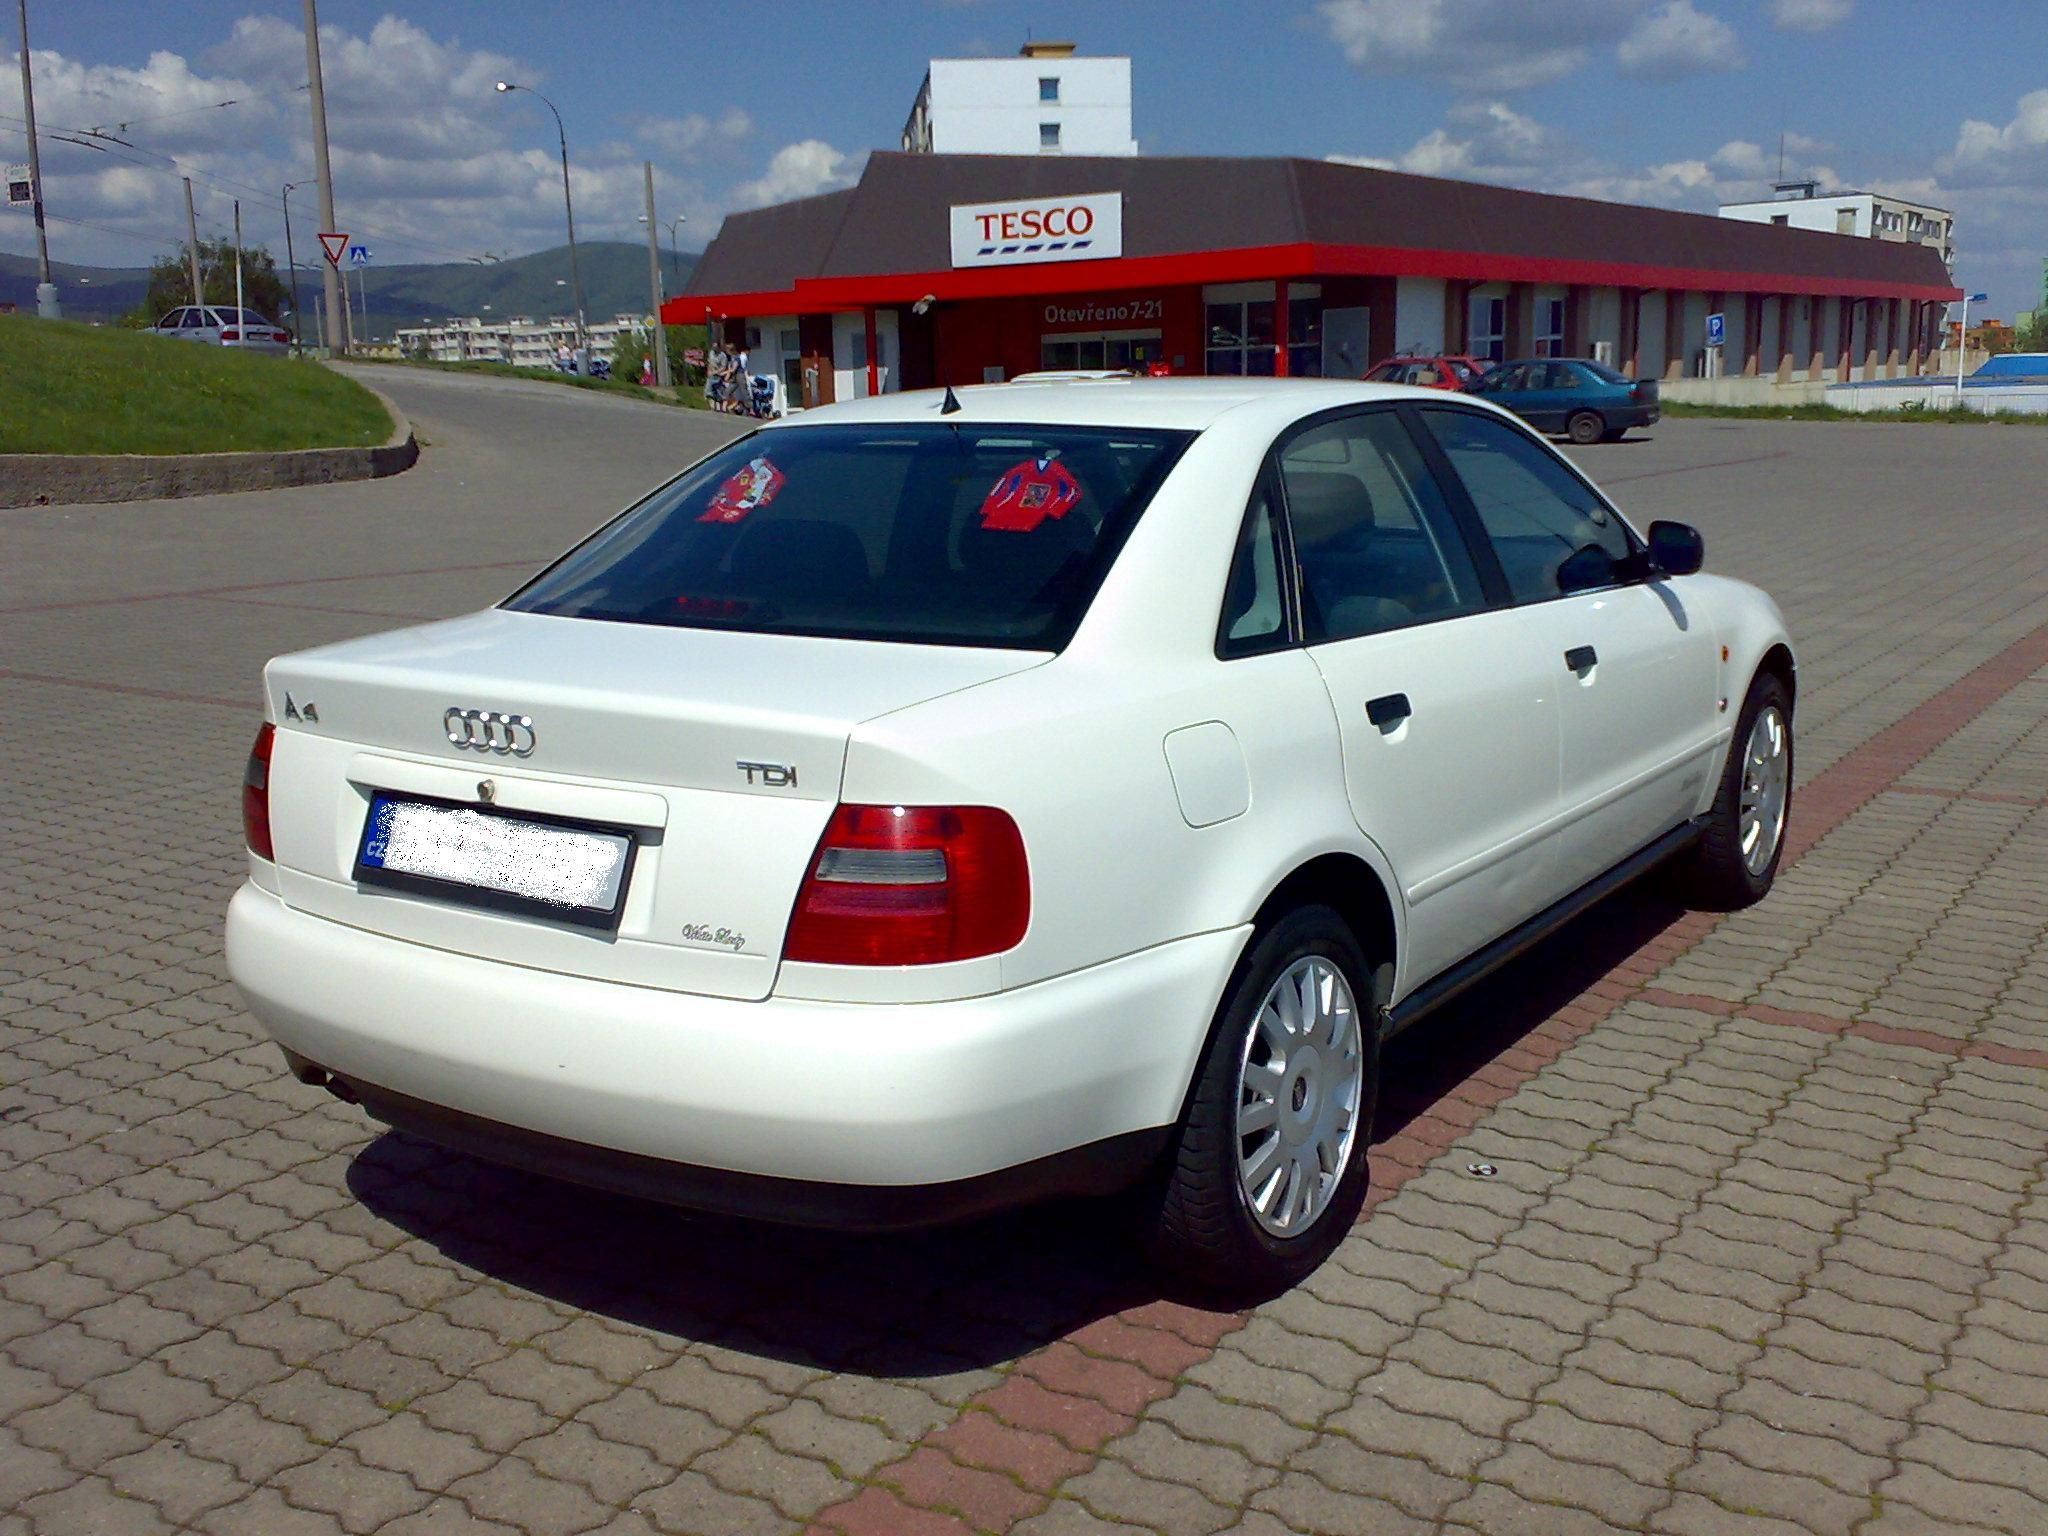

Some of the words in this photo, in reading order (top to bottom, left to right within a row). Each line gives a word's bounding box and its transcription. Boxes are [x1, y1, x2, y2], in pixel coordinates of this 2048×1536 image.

[975, 206, 1095, 241] TESCO
[1044, 302, 1128, 323] Otevřeno
[1130, 299, 1162, 320] 7-21
[1711, 318, 1721, 336] P
[285, 691, 319, 723] A4
[736, 760, 798, 788] TDI
[366, 840, 385, 858] CZ
